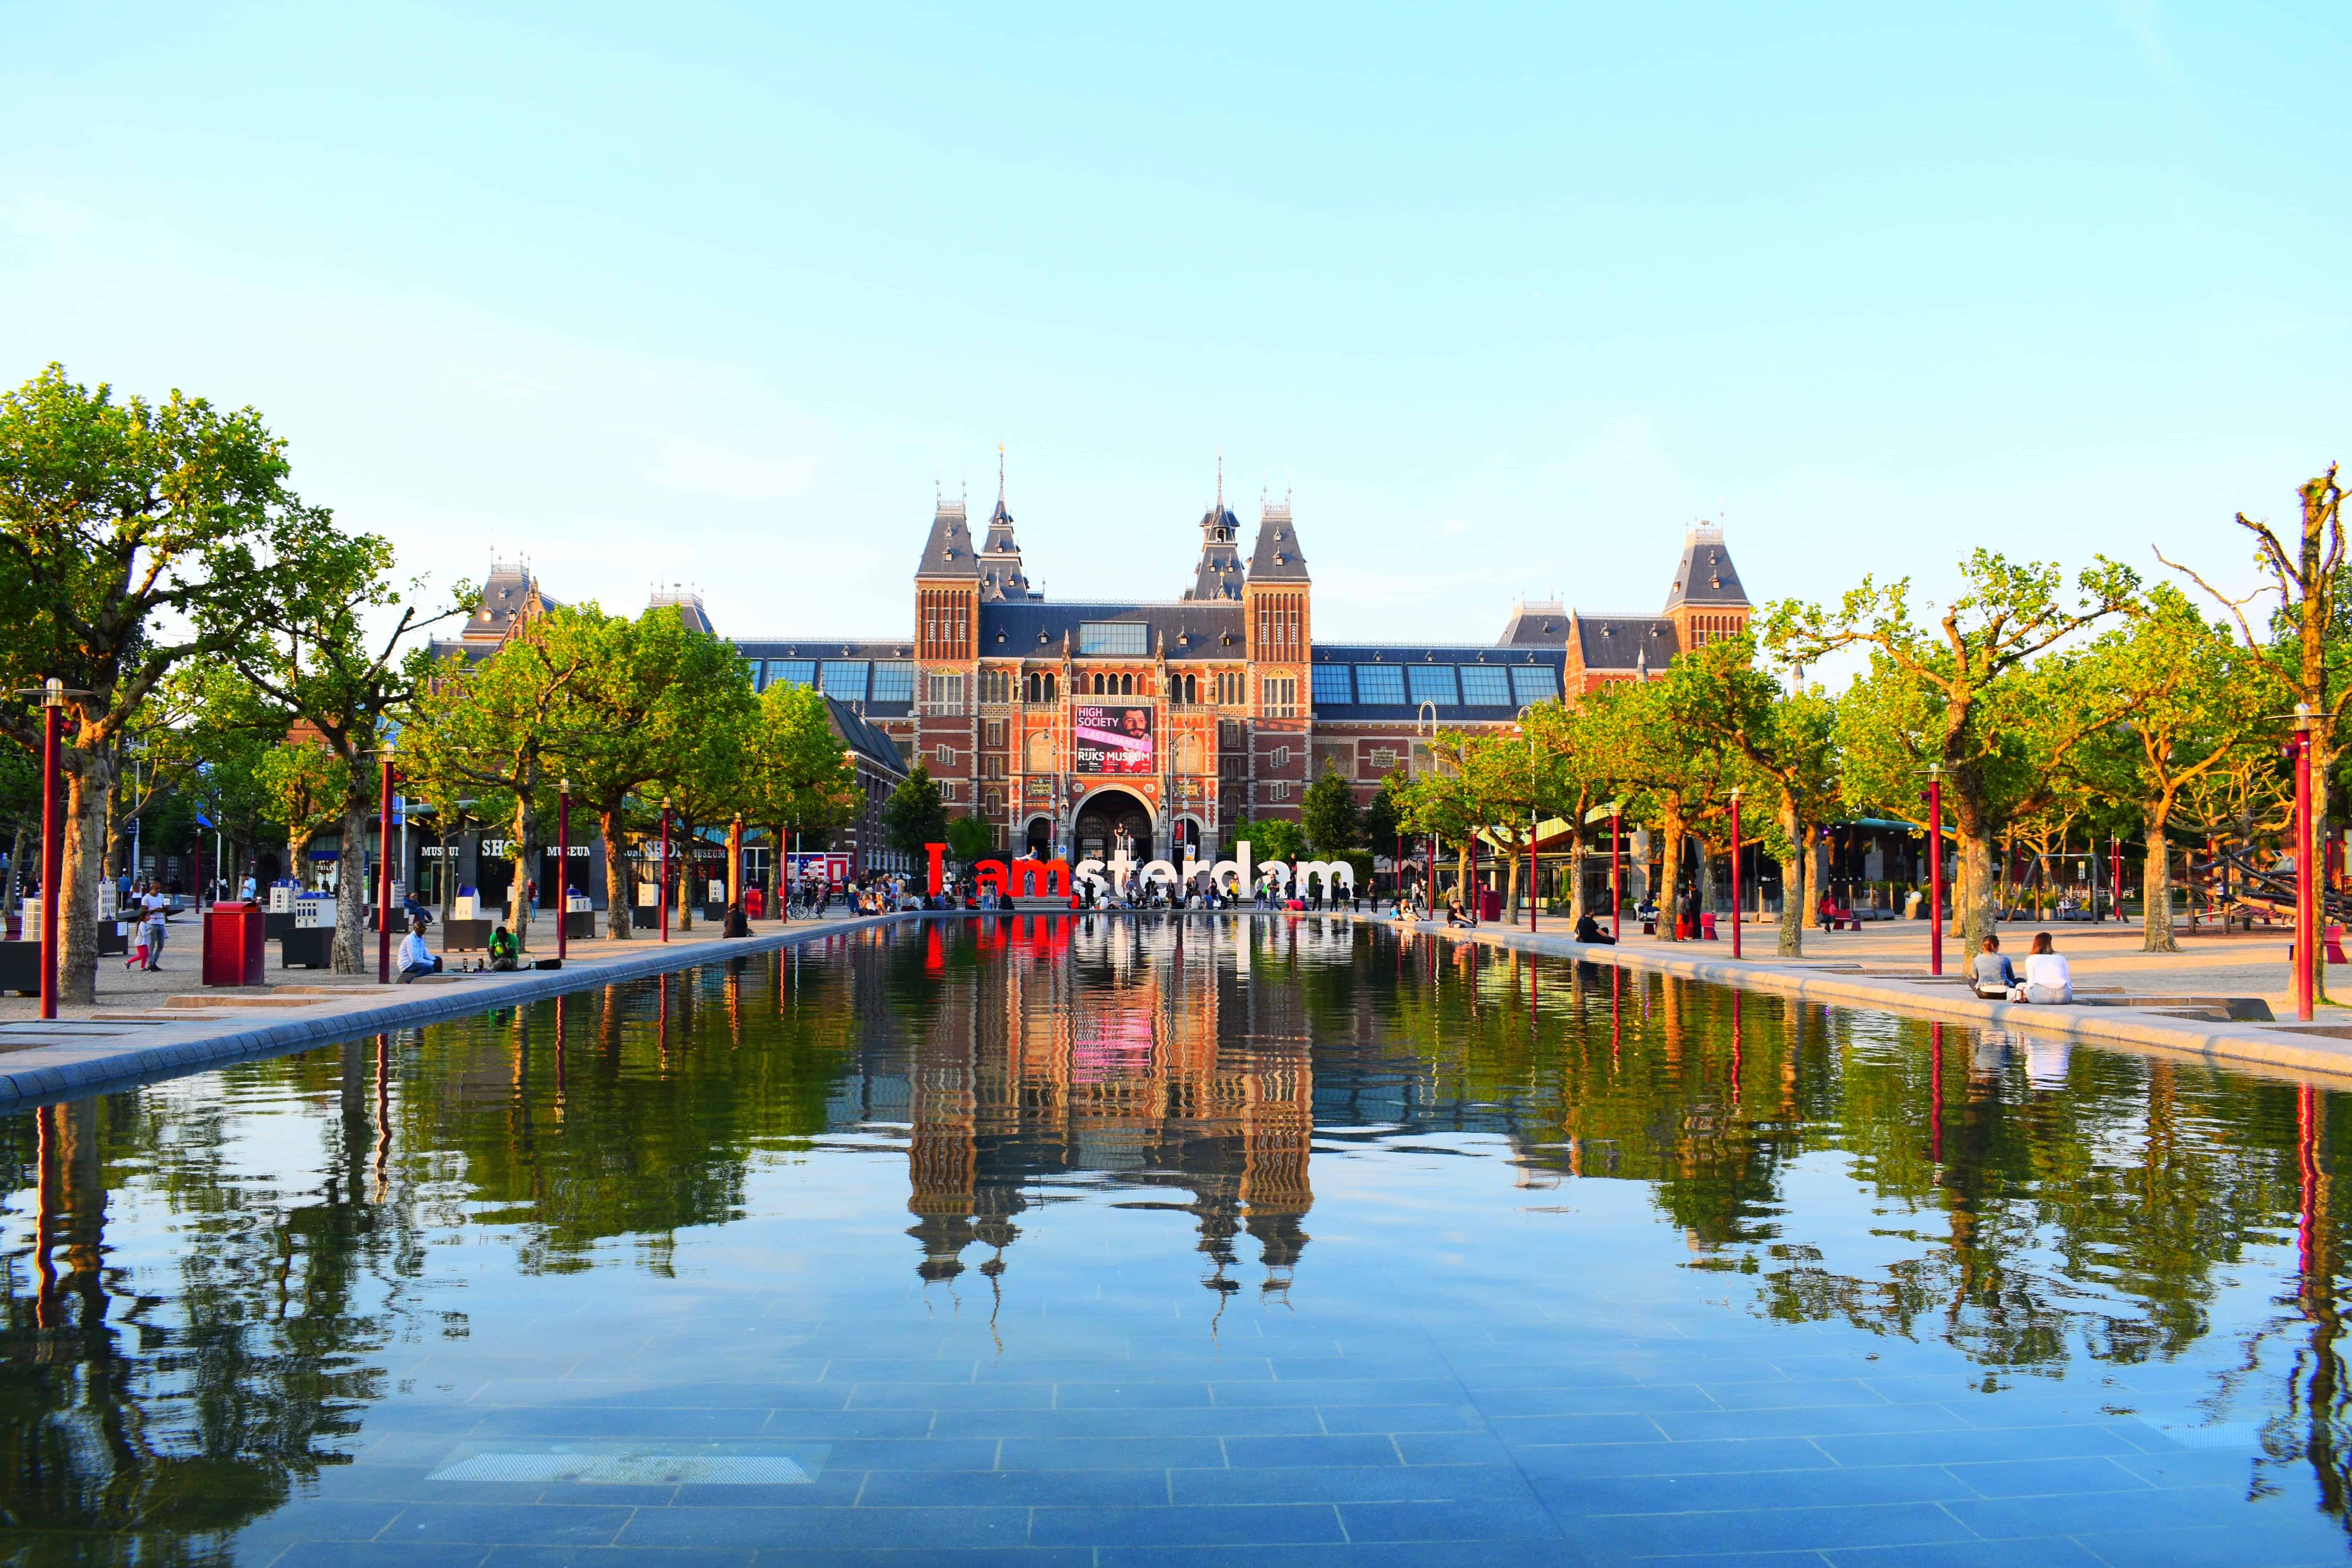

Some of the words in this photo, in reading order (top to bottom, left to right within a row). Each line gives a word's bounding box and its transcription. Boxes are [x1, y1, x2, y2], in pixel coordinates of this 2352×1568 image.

[1078, 707, 1103, 717] HIGH
[1078, 717, 1119, 727] SOCIETY
[1084, 729, 1105, 741] LAST
[1107, 734, 1144, 748] CHANCE!
[1107, 752, 1150, 761] MUSEUM
[421, 847, 459, 856] MUSU
